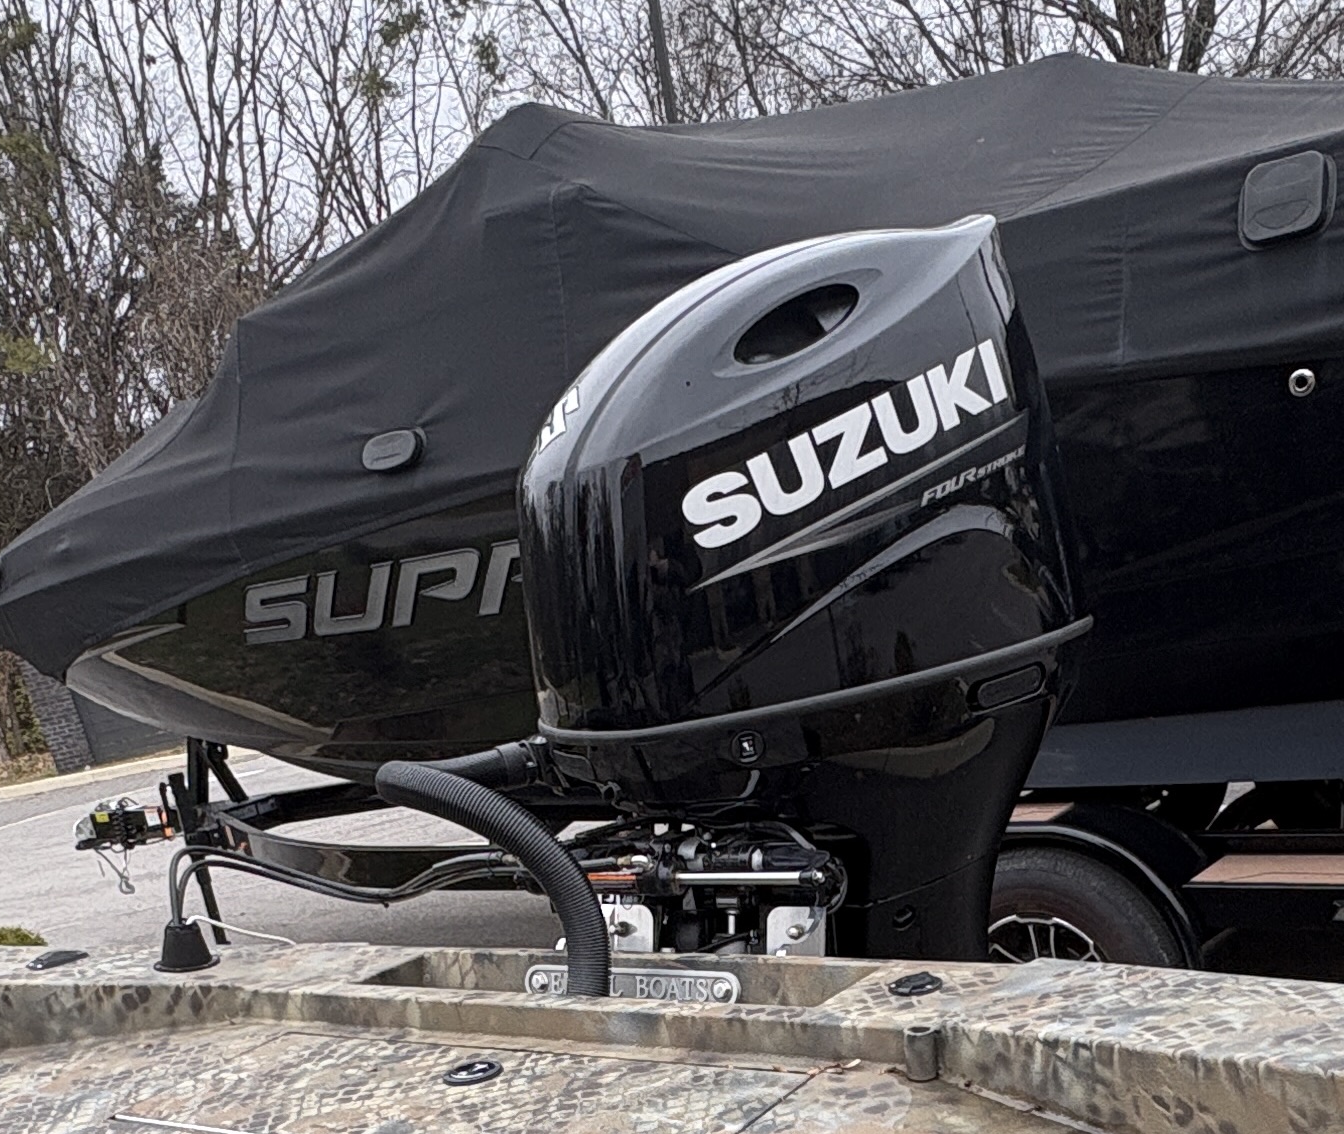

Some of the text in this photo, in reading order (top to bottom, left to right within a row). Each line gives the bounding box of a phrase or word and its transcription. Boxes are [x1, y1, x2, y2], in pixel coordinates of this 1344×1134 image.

[682, 338, 1008, 549] SUZUKI
[243, 538, 522, 646] SUP
[635, 975, 708, 1001] BOATS
